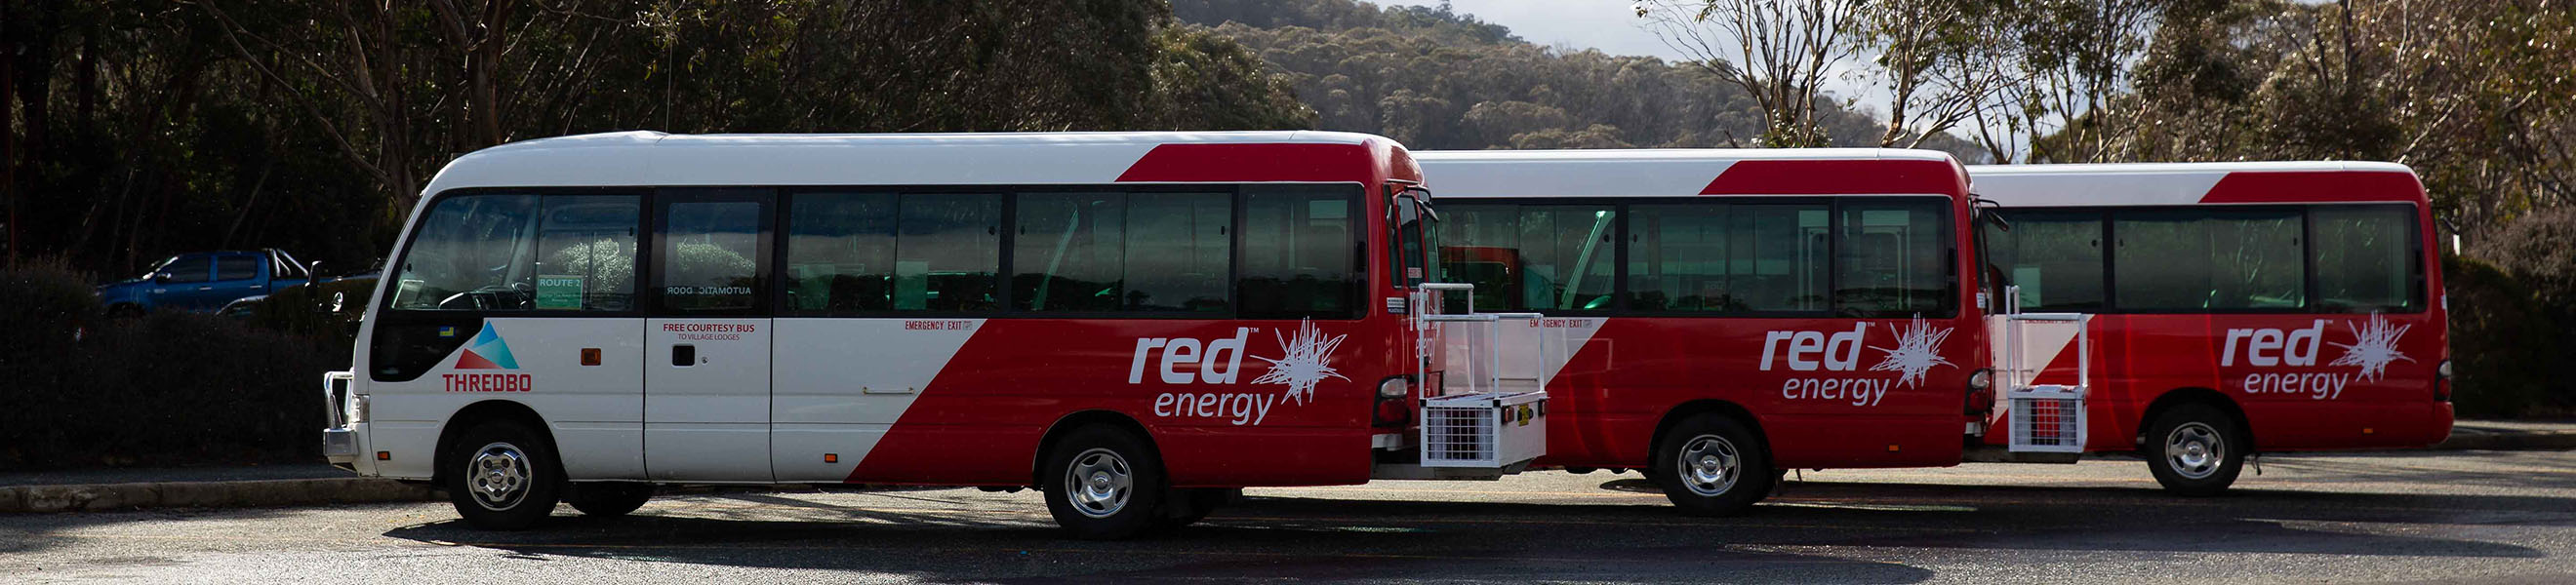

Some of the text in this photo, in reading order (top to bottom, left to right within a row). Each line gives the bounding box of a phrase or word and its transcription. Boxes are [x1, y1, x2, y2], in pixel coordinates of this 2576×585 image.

[664, 323, 755, 333] FREE COURTESY BUS
[905, 320, 962, 330] EMERGENCY EXIT
[1529, 319, 1583, 328] EMRGENCY EXIT
[1128, 327, 1250, 384] red
[1759, 321, 1867, 370] red
[2221, 319, 2325, 367] red
[442, 373, 532, 392] THREDBO
[1783, 378, 1890, 406] energy
[2244, 372, 2349, 400] energy
[1154, 392, 1274, 426] energy
